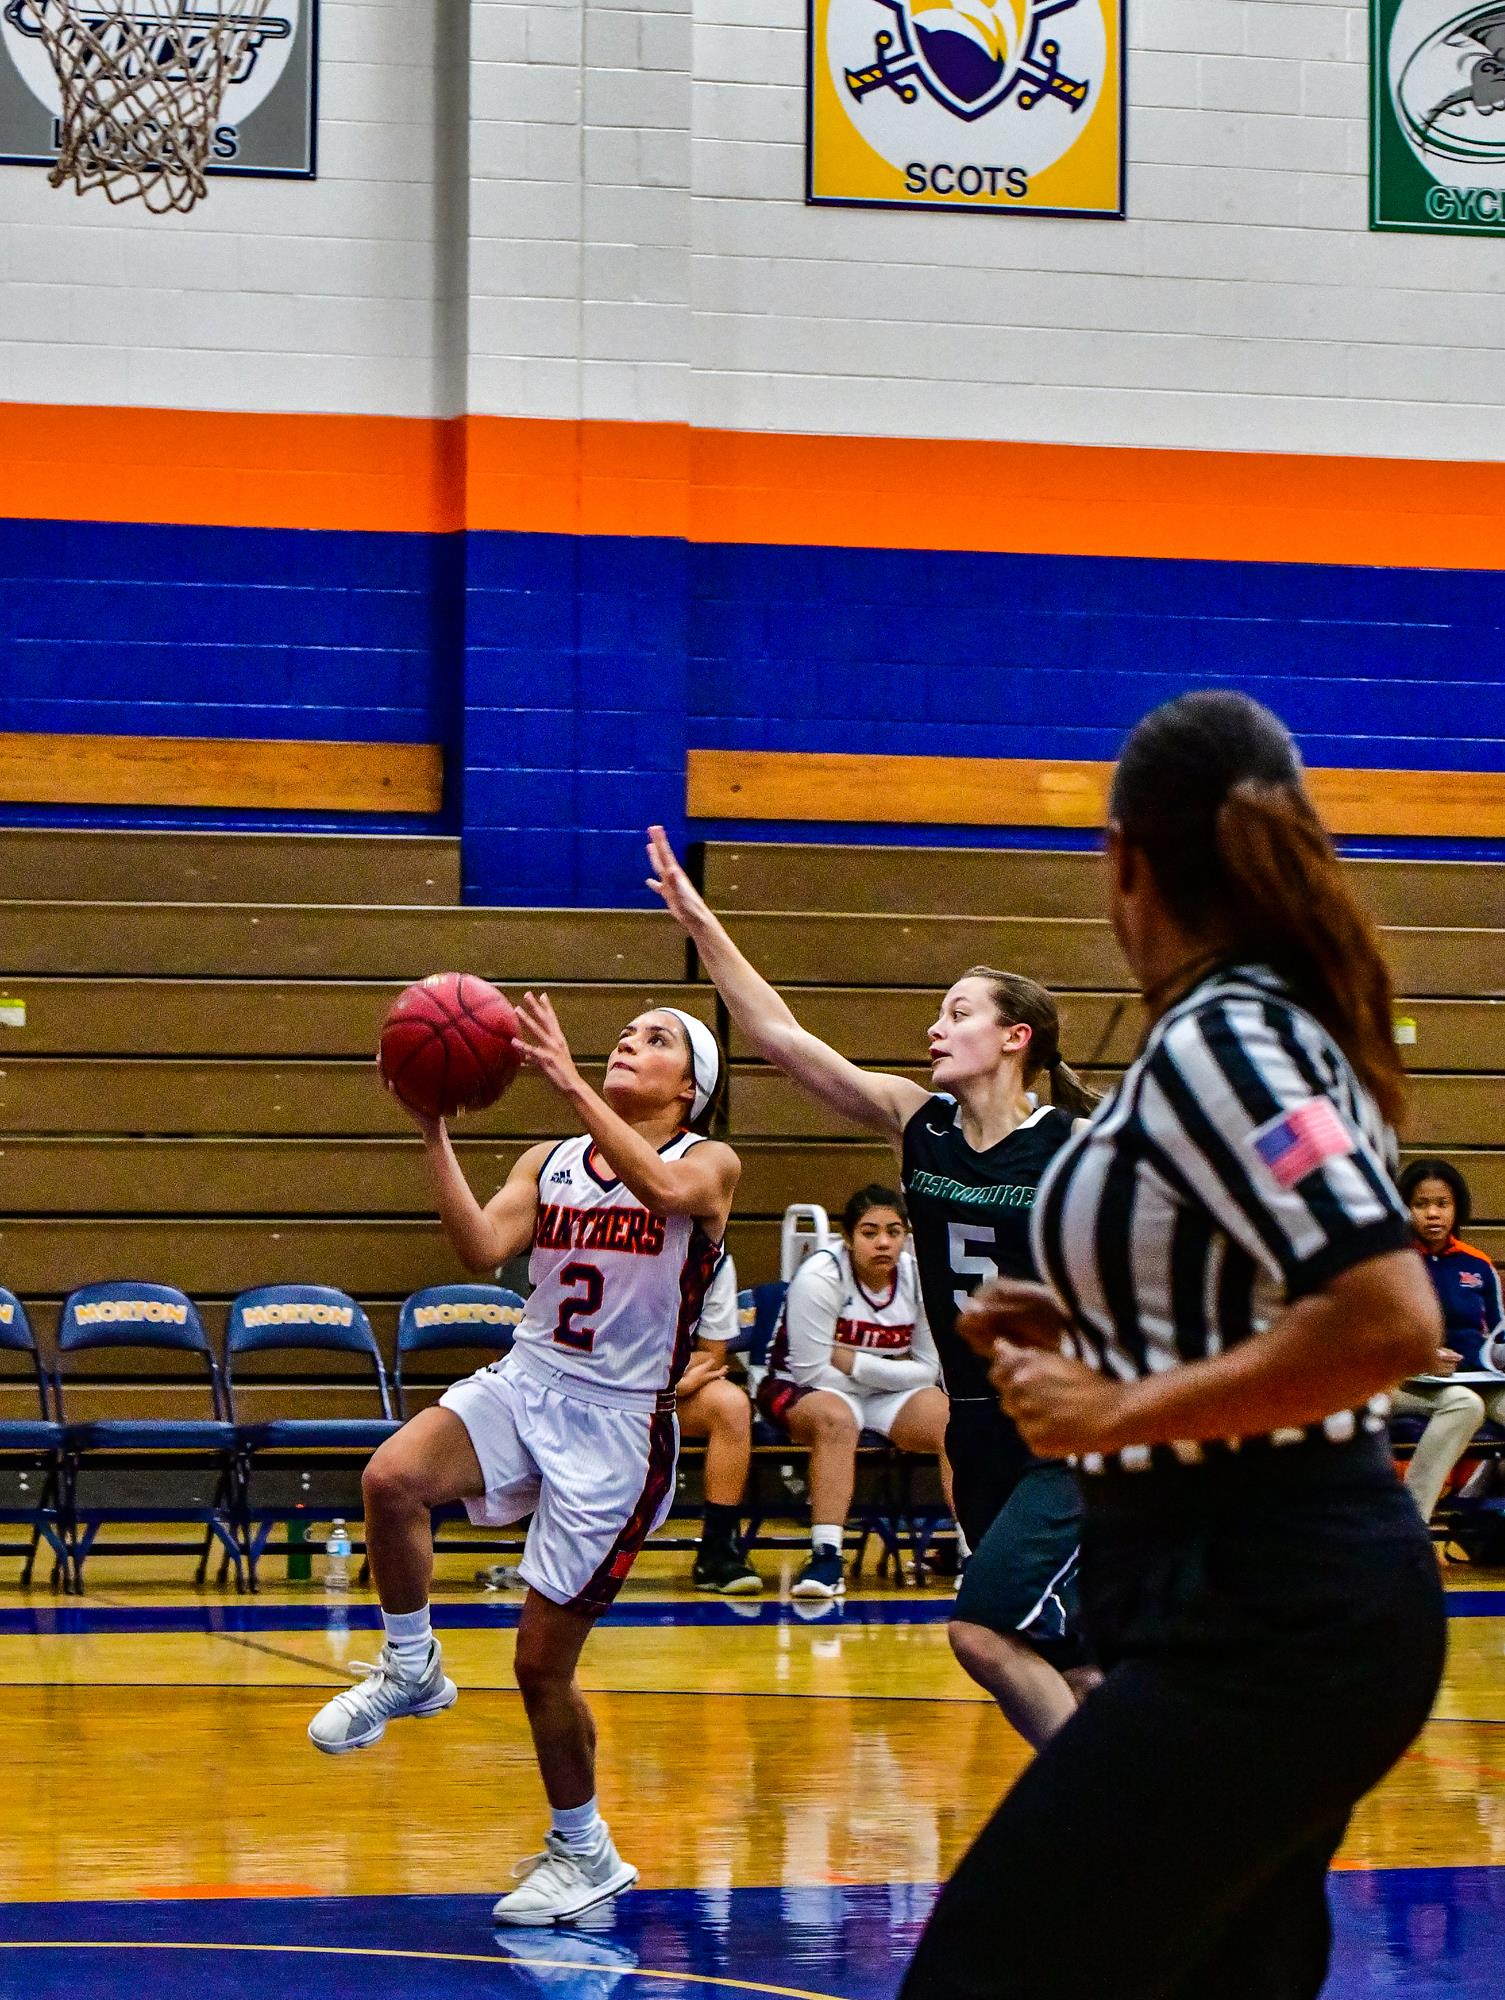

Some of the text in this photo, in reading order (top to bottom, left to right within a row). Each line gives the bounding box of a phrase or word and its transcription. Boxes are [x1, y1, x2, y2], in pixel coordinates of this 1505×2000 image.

[904, 162, 1028, 198] SCOTS
[947, 1221, 999, 1313] 5
[73, 1300, 188, 1326] MORTON
[242, 1303, 353, 1328] MORTON
[413, 1303, 524, 1328] MORTON
[553, 1262, 605, 1352] 2
